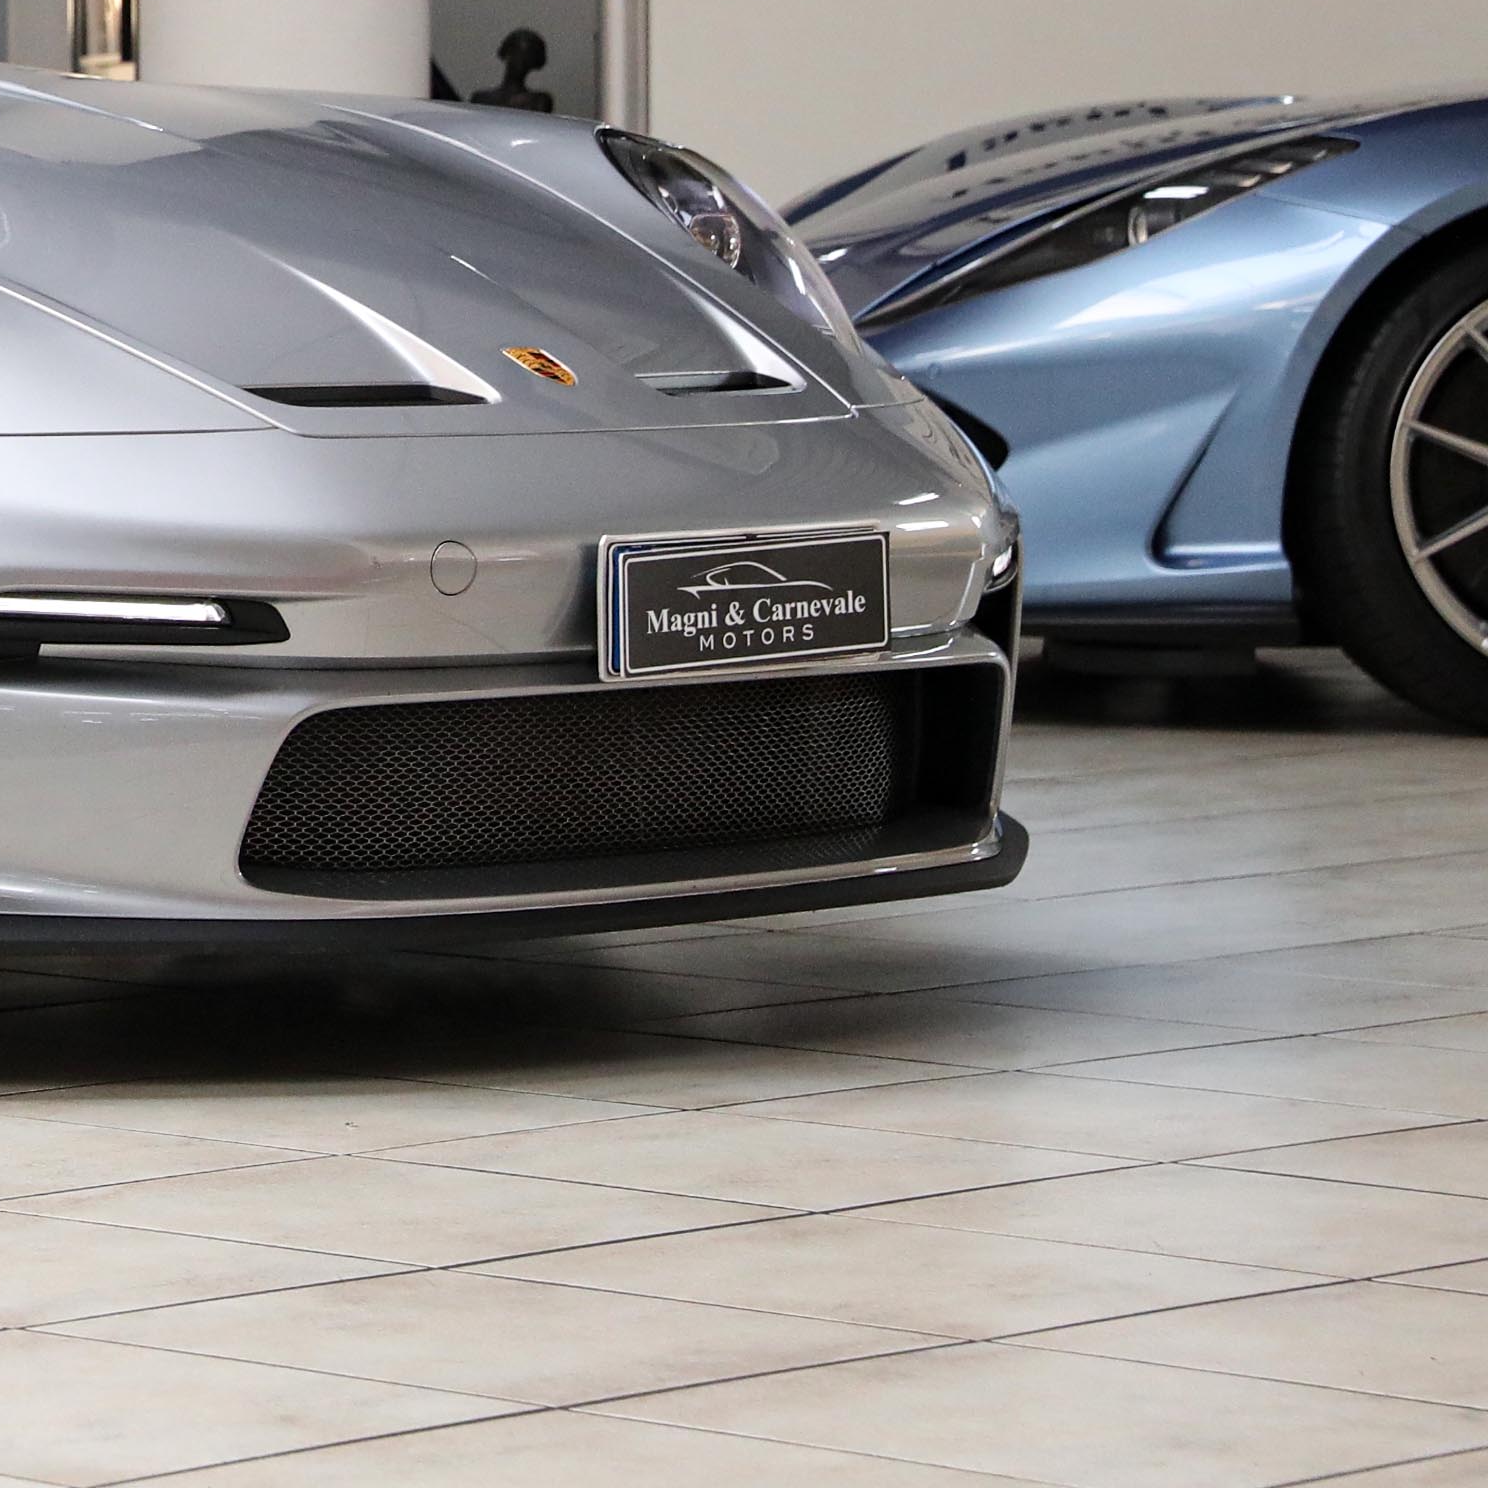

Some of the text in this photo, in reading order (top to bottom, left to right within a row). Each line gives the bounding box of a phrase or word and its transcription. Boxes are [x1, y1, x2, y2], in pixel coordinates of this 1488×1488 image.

[646, 589, 867, 637] Magni & Carnevale
[698, 623, 815, 652] MOTORS
